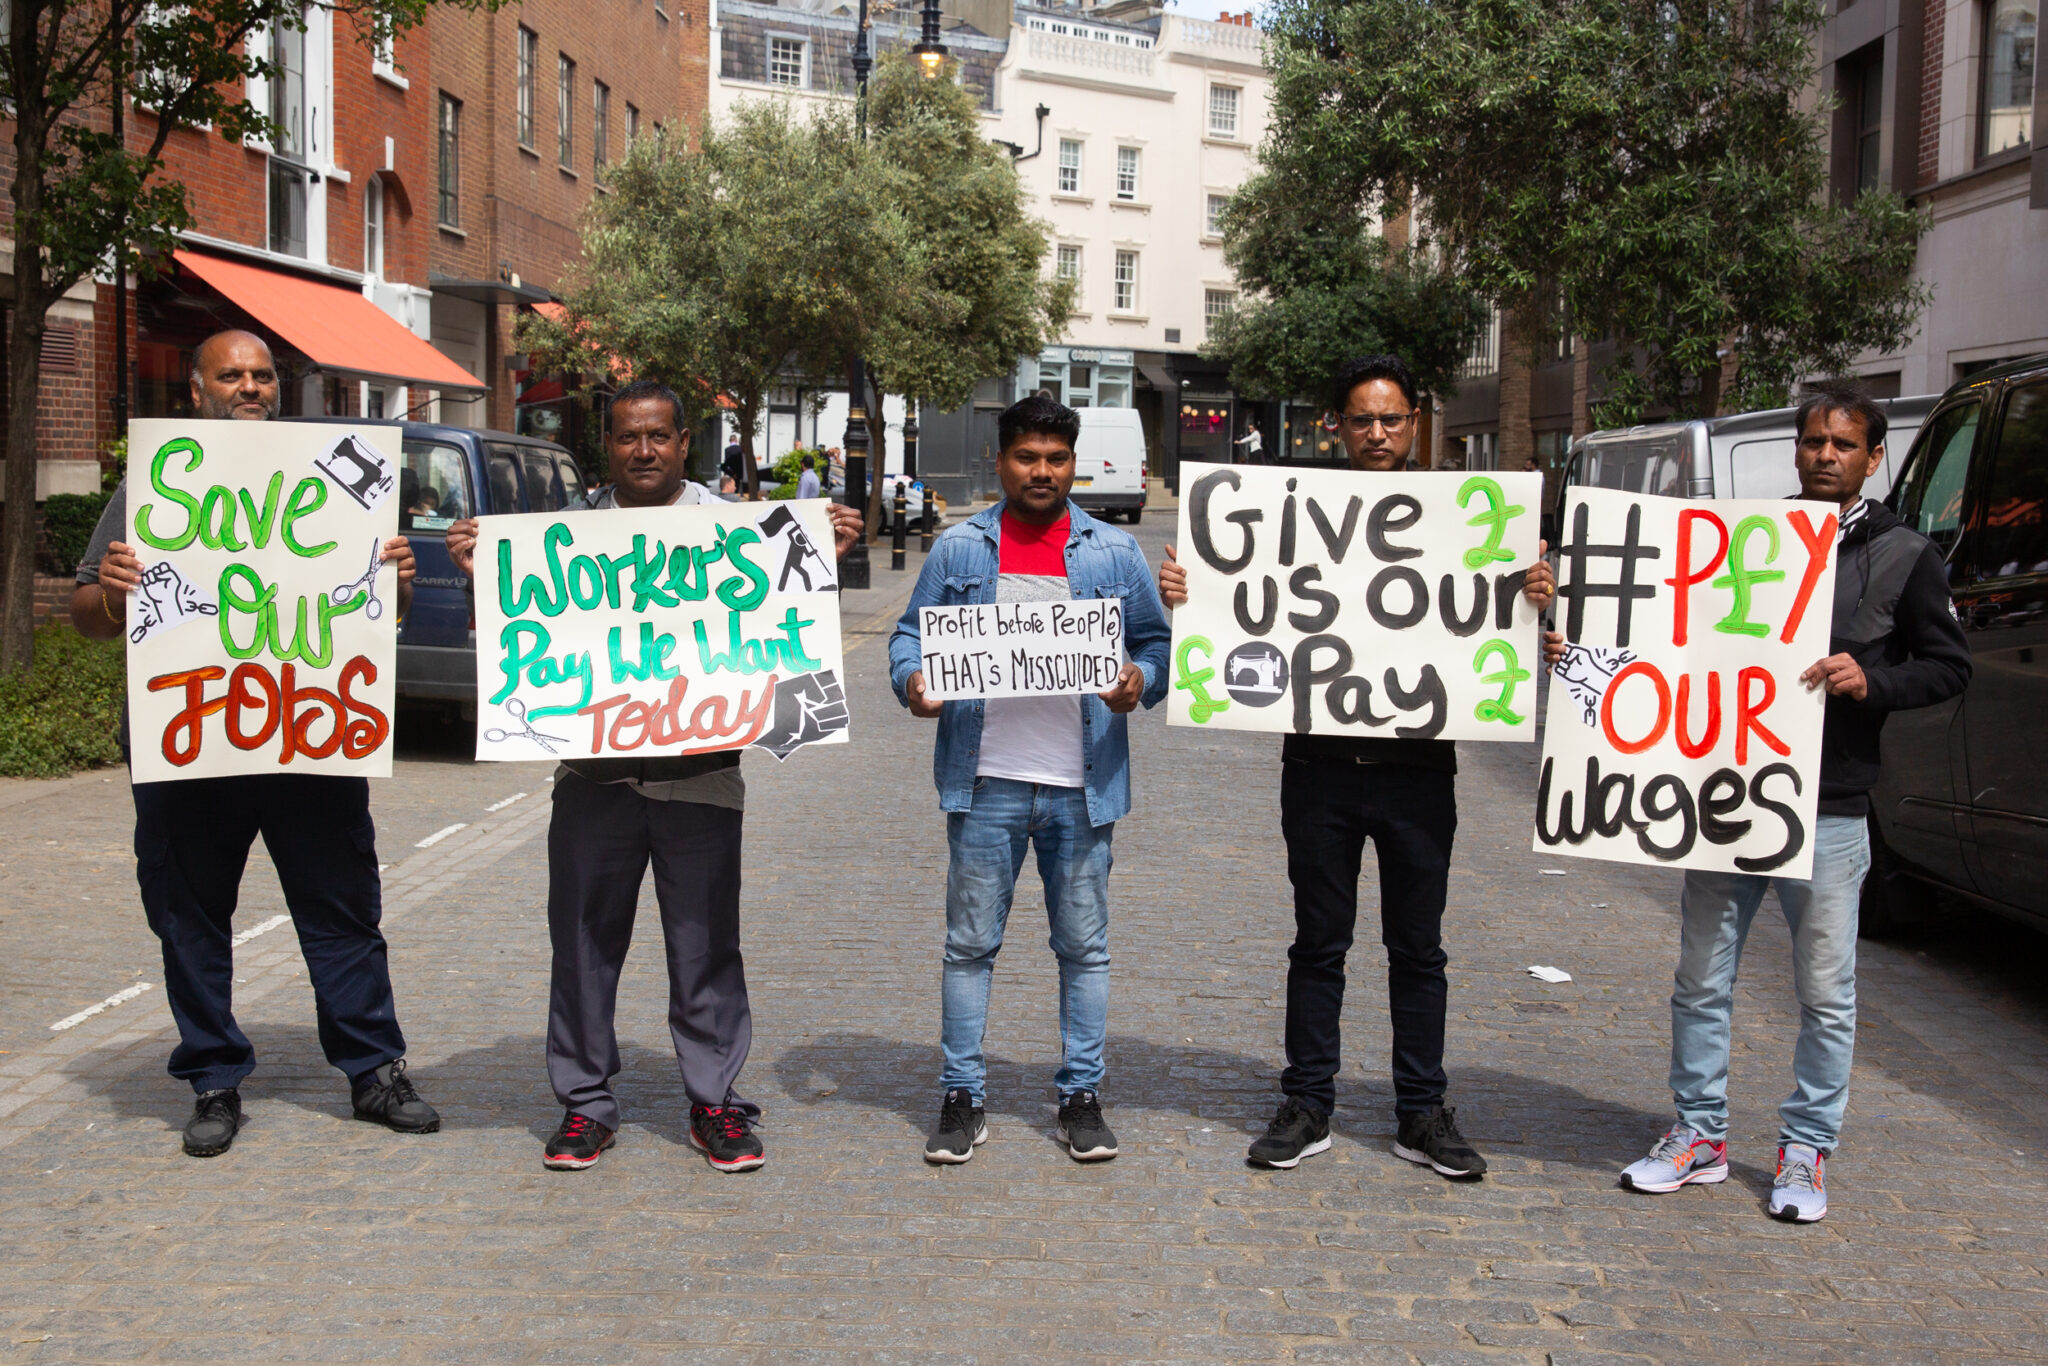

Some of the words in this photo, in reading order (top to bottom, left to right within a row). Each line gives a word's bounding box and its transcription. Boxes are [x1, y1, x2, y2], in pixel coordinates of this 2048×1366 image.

[134, 437, 338, 558] Save
[1188, 468, 1424, 575] Give
[218, 563, 369, 669] Our
[925, 606, 987, 639] Profit
[995, 604, 1045, 636] before
[1233, 563, 1341, 637] us
[489, 619, 594, 723] Pay
[608, 622, 680, 684] We
[693, 607, 821, 674] Want
[577, 674, 779, 756] Today
[1290, 633, 1448, 739] Pay
[1601, 661, 1792, 766] OUR
